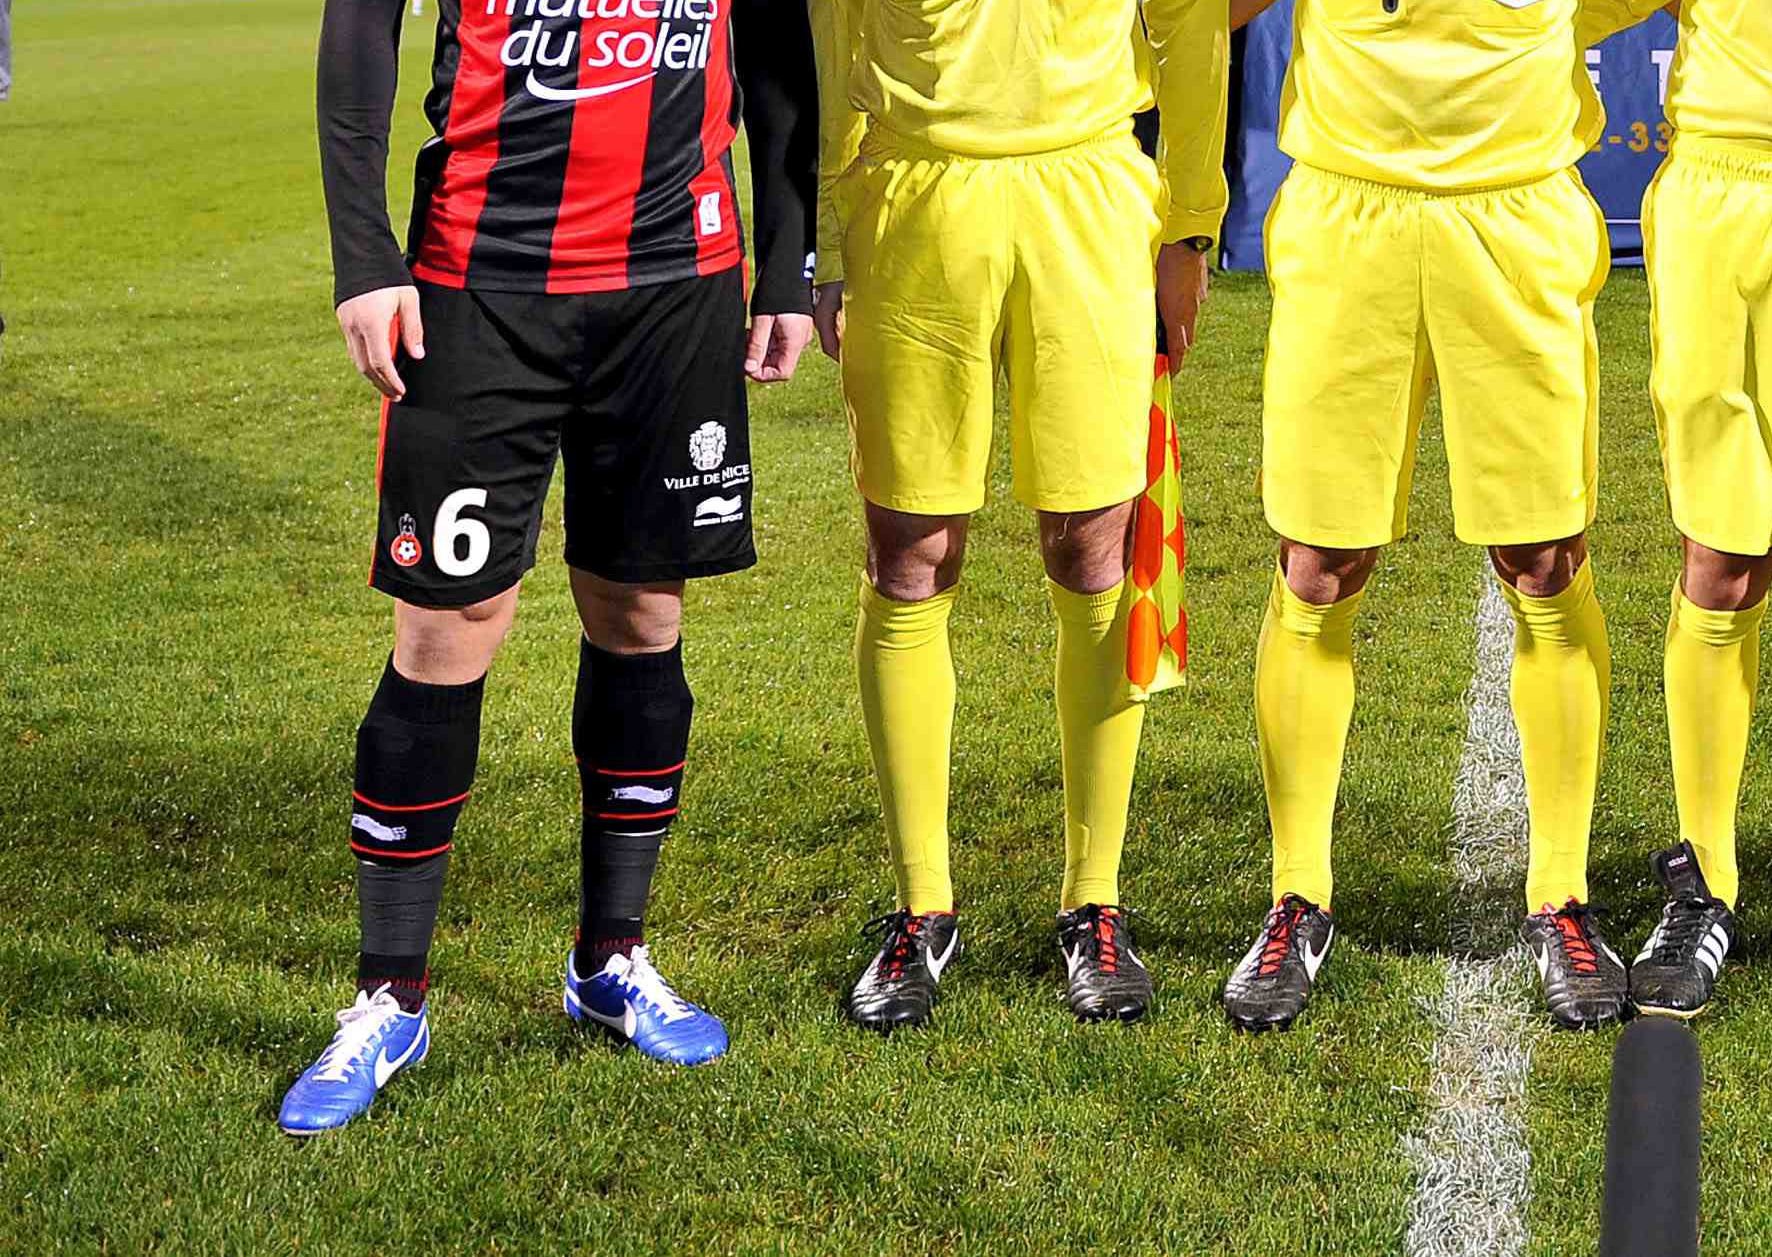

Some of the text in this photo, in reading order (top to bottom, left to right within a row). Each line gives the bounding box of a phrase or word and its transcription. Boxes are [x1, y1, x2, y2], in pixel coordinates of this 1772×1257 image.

[500, 20, 713, 70] du soleil
[664, 475, 700, 490] VILLE
[703, 473, 721, 486] DE
[721, 464, 750, 482] NICE
[433, 488, 491, 577] 6
